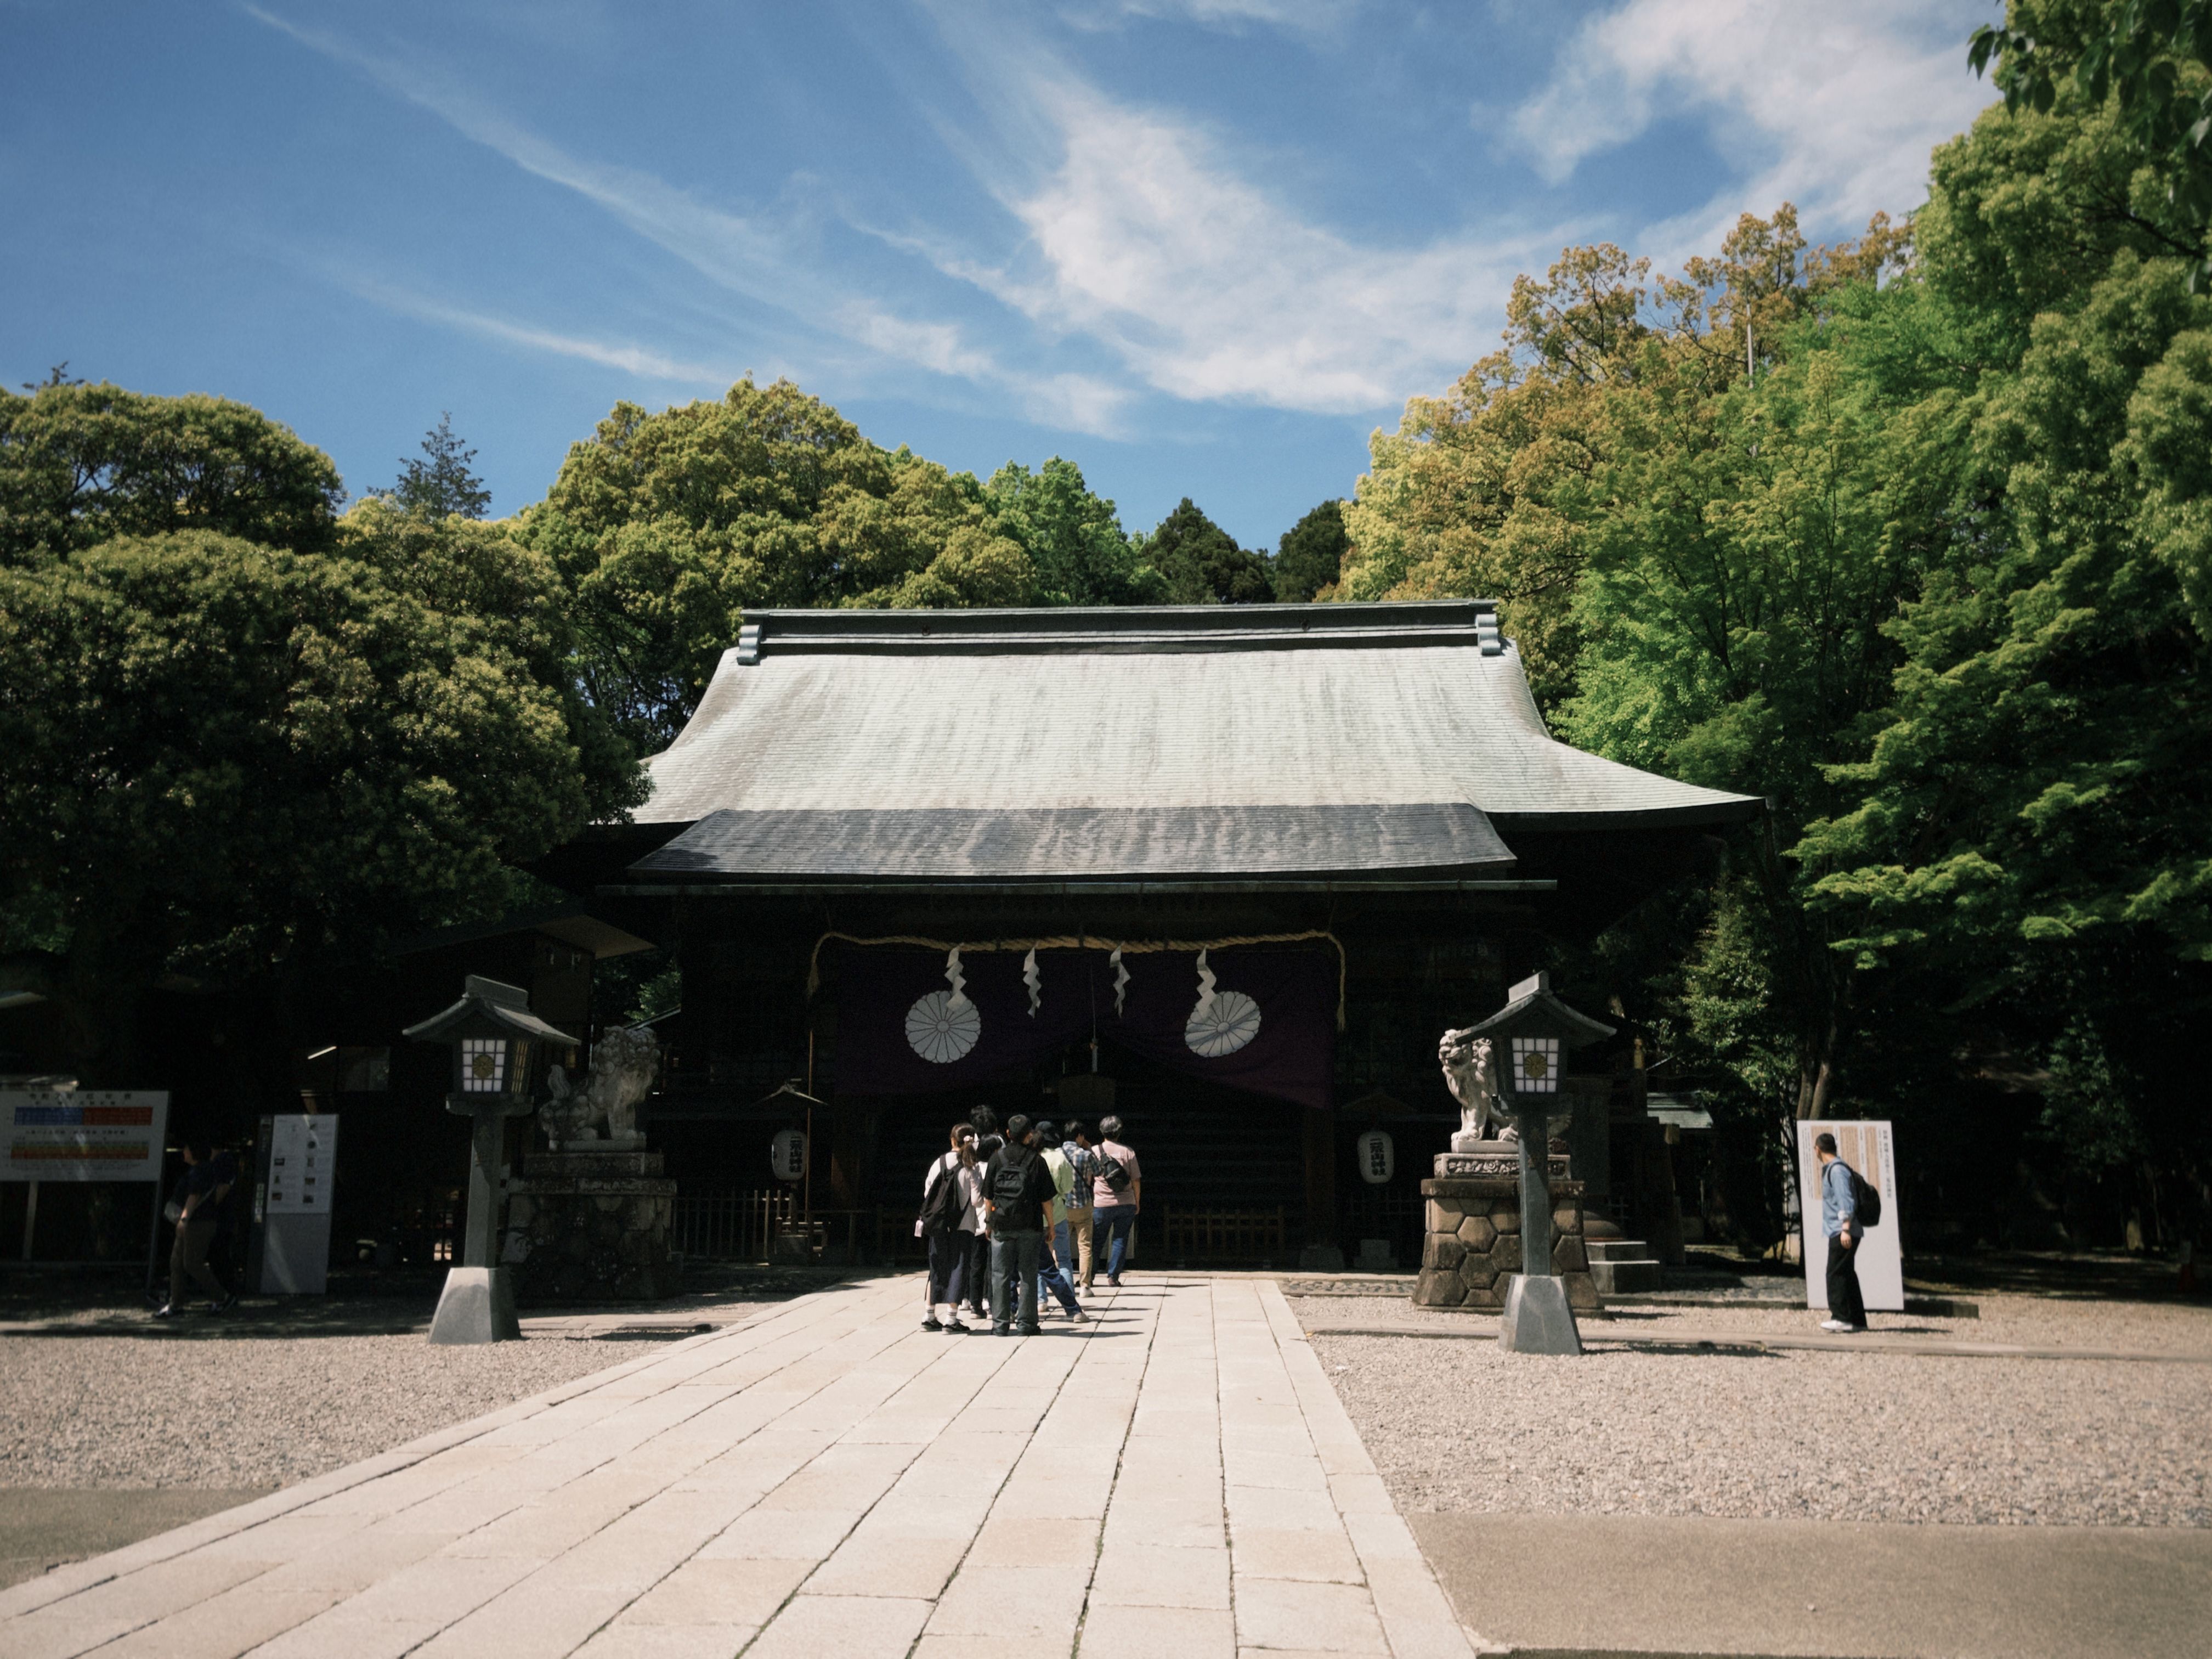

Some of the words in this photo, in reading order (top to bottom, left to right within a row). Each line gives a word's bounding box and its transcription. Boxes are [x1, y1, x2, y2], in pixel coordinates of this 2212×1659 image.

[789, 1136, 803, 1173] 二荒山神社
[1370, 1138, 1386, 1176] 二荒山神社
